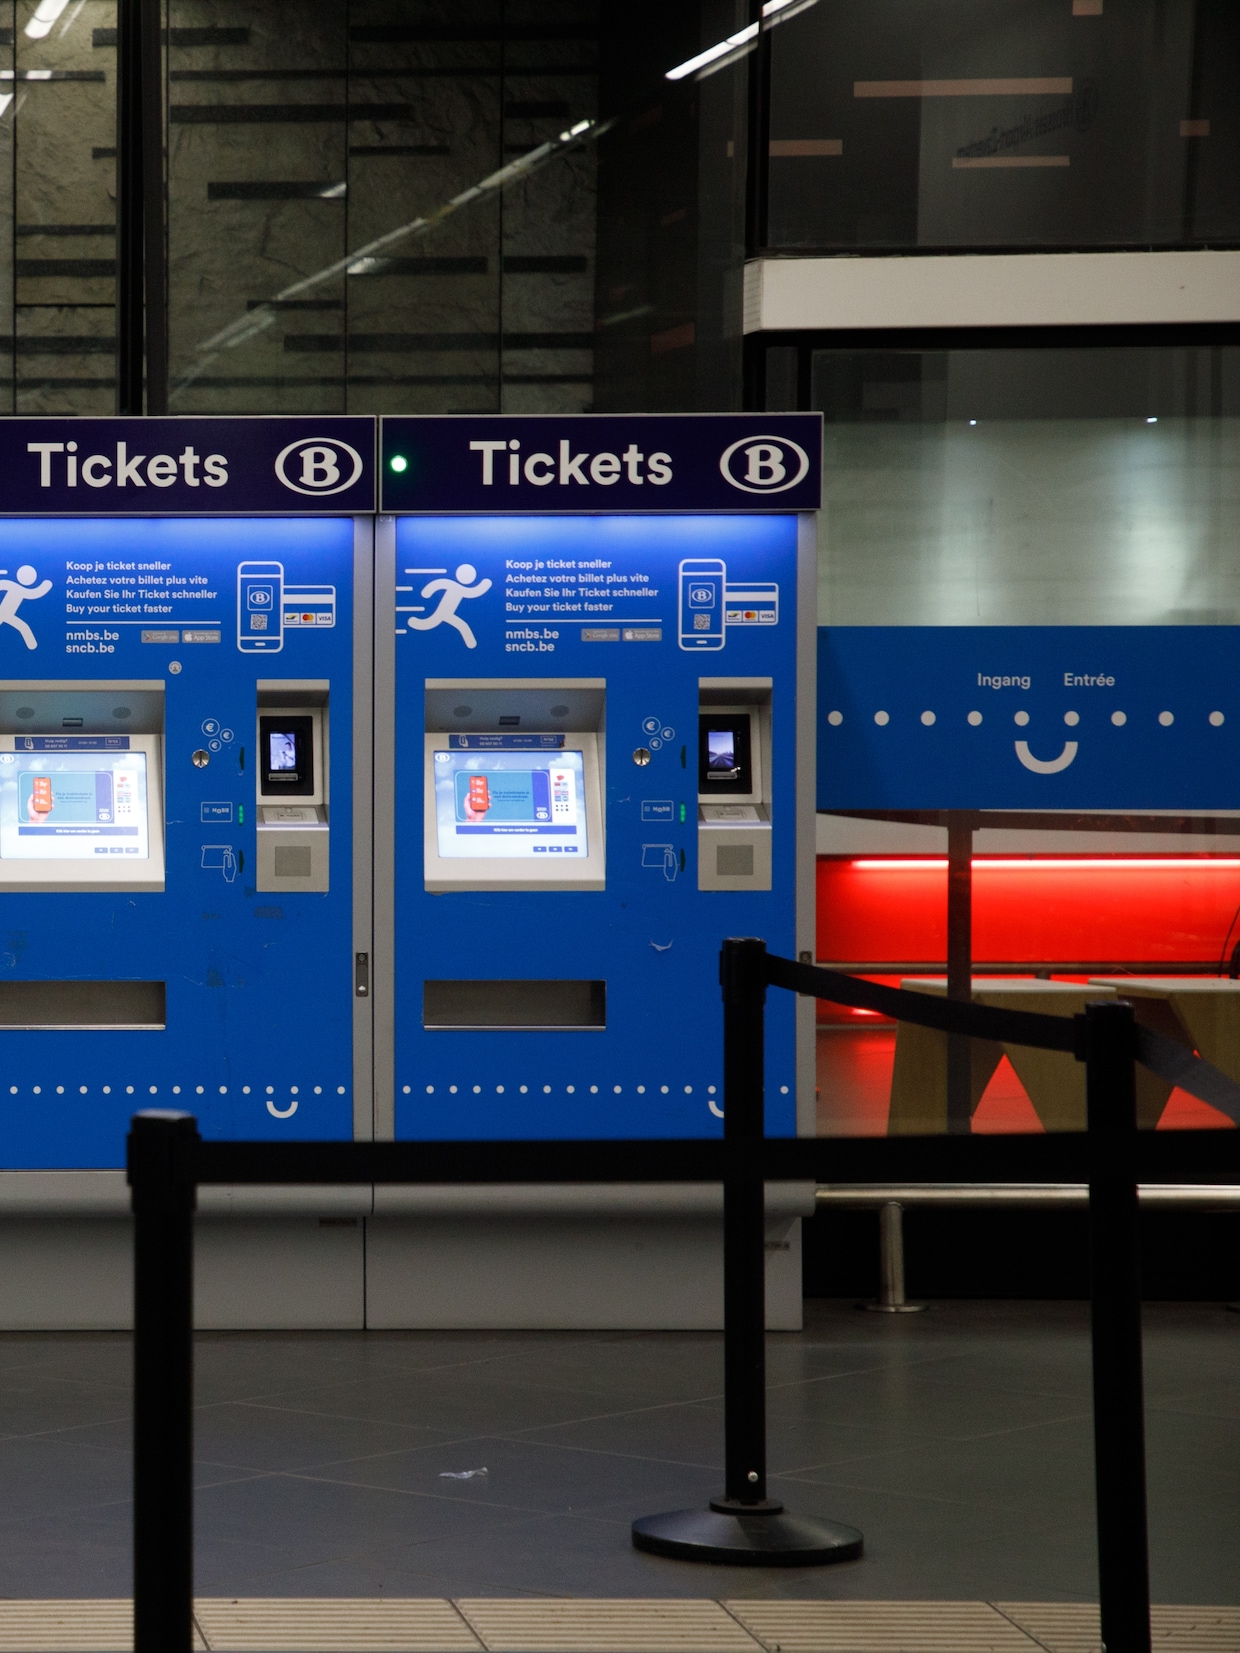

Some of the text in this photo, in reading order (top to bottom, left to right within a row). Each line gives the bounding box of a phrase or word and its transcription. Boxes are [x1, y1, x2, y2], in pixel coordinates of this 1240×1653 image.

[28, 441, 228, 487] Tickets
[470, 439, 672, 485] Tickets
[66, 560, 172, 573] Koop je ticket sneller
[505, 559, 612, 571] Koop je ticket sneller
[65, 575, 209, 587] Achetez votre billet plus vite
[505, 573, 650, 585] Achetez votre billet plus vite
[66, 589, 218, 599] Kaufen Sie Ihr Ticket schneller
[505, 587, 659, 598] Kaufen Sie Ihr Ticket schneller
[66, 603, 173, 615] Buy your ticket faster
[505, 601, 614, 614] Buy your ticket faster
[65, 629, 120, 641] nmbs.be
[505, 627, 560, 640] nmbs.be
[65, 641, 116, 654] sncb.be
[505, 640, 556, 652] sncb.be
[977, 672, 1031, 690] Ingang
[1063, 672, 1116, 687] Entrée
